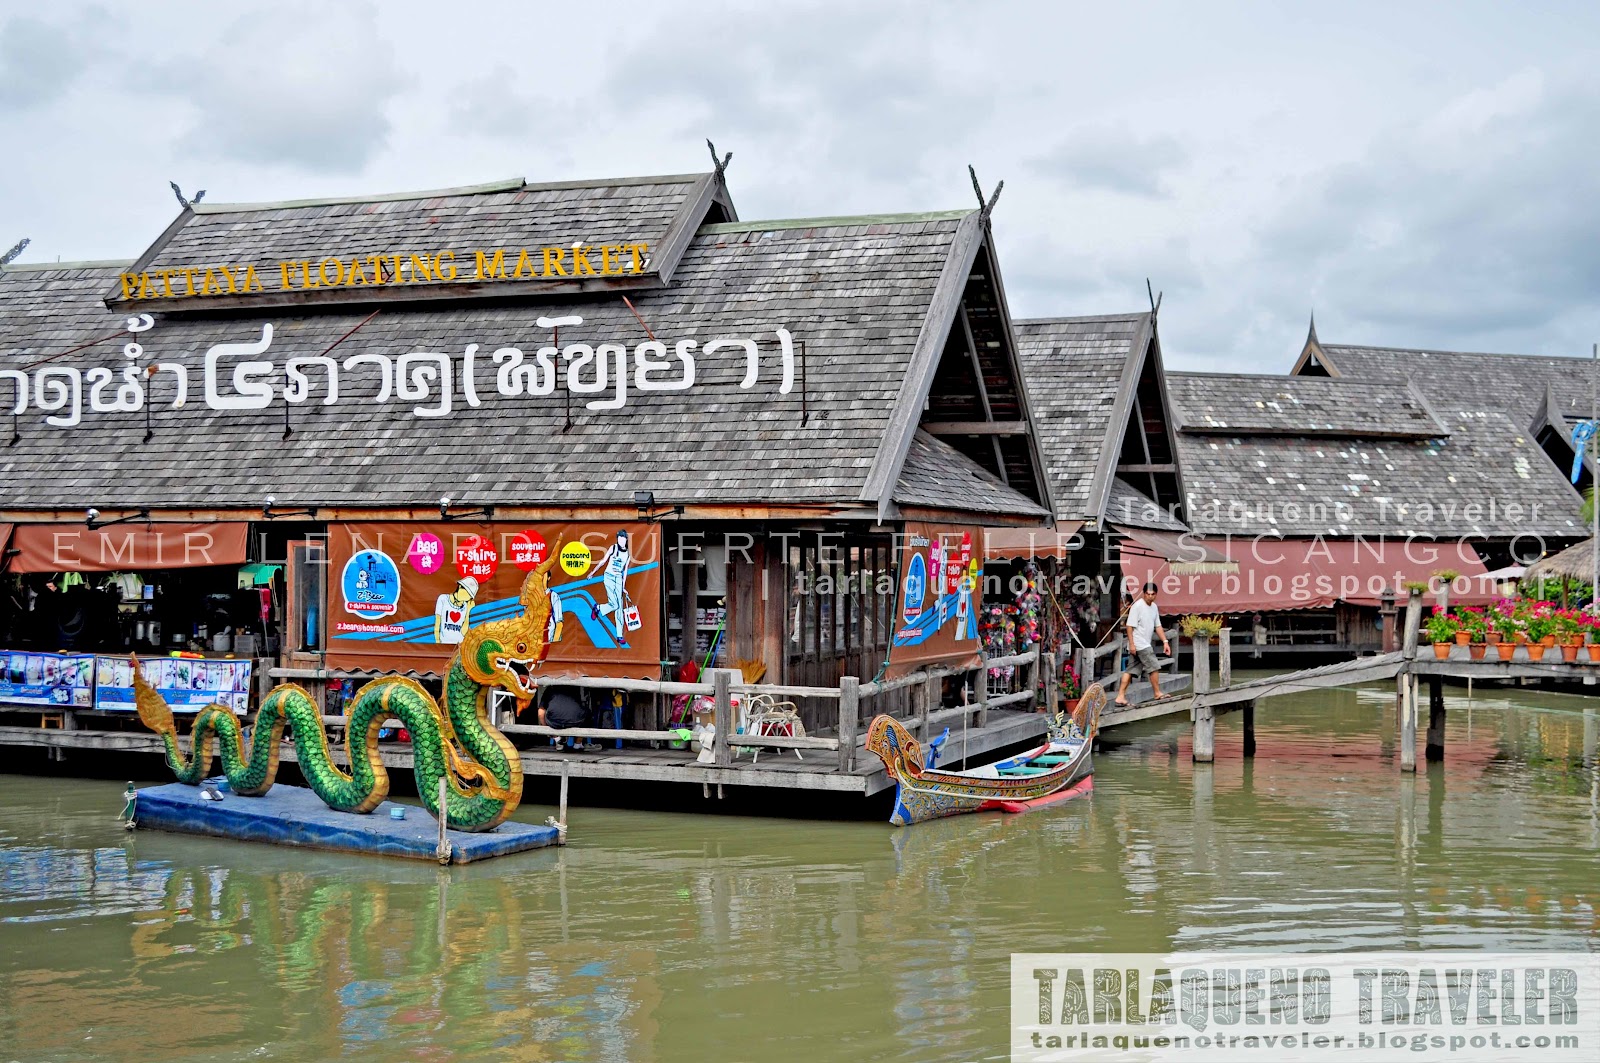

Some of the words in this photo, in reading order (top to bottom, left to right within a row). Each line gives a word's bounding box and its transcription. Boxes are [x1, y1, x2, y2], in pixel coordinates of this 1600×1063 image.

[119, 264, 264, 299] PATTAYA
[278, 250, 458, 290] FLOATING
[473, 242, 648, 279] MARKET
[416, 540, 438, 554] Bag
[445, 610, 449, 623] I
